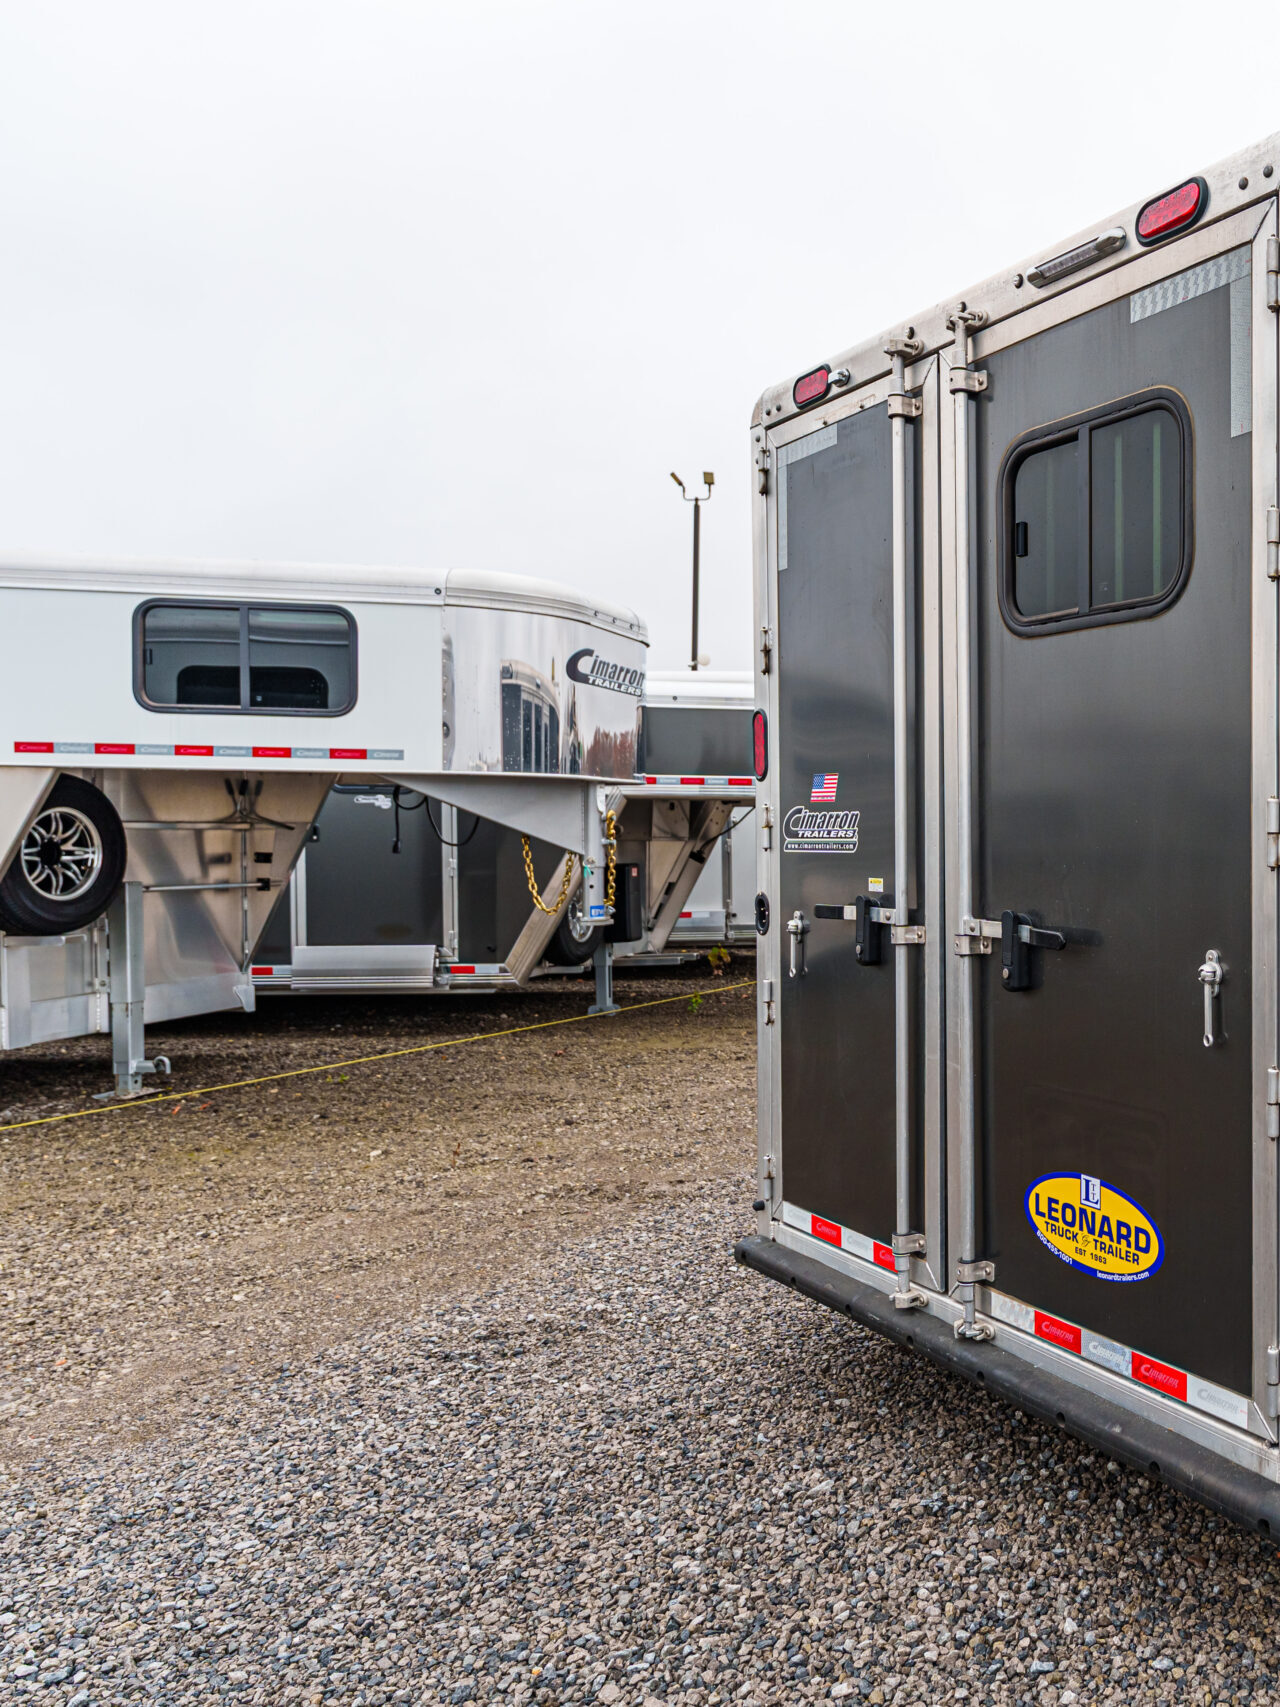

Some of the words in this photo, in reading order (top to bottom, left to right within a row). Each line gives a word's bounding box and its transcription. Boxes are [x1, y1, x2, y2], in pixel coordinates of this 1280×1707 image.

[566, 648, 645, 687] Cimarron
[588, 676, 642, 696] TRAILERS
[784, 807, 859, 833] Cimarron
[797, 830, 854, 838] TRAILERS
[1035, 1193, 1151, 1254] LEONARD
[1045, 1221, 1078, 1243] TRUCK
[1093, 1239, 1140, 1265] TRAILER
[1075, 1247, 1086, 1257] EST
[1090, 1252, 1107, 1265] 1963
[1097, 1270, 1149, 1282] leonardtrailers.com
